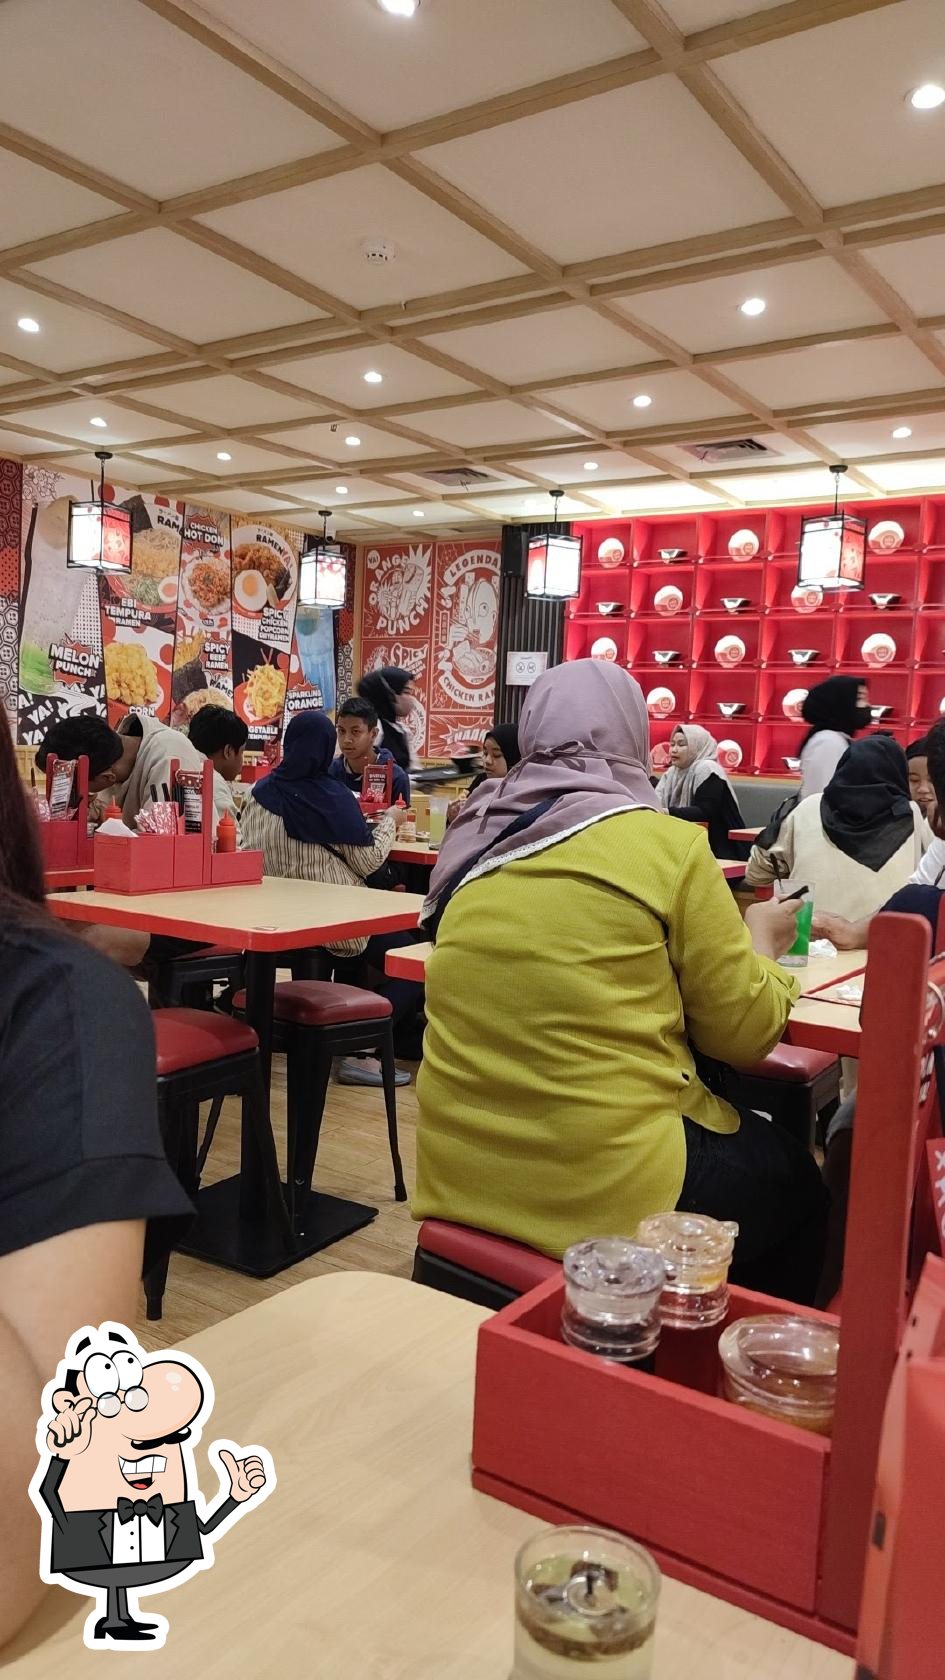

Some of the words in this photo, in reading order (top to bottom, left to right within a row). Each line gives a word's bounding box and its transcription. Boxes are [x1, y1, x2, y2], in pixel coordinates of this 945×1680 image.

[190, 522, 218, 533] CHICKEN
[184, 529, 202, 540] HOT
[204, 533, 224, 546] DON
[449, 554, 501, 578] LEGENDA
[121, 598, 137, 609] EBI
[105, 605, 151, 621] TEMPURA
[263, 607, 287, 619] SPICY
[376, 598, 429, 635] PUNCH
[115, 618, 141, 627] RAMEN
[260, 625, 289, 635] POPCORN
[204, 642, 231, 654] SPICY
[50, 643, 100, 669] MELON
[55, 659, 93, 677] PUNCH
[205, 661, 228, 669] RAMEN
[288, 689, 321, 699] SPARKLING
[443, 676, 475, 701] CHICKEN
[288, 698, 323, 710] ORANGE
[27, 699, 54, 725] YA!
[129, 705, 156, 716] CORN
[248, 726, 278, 734] GETABLE
